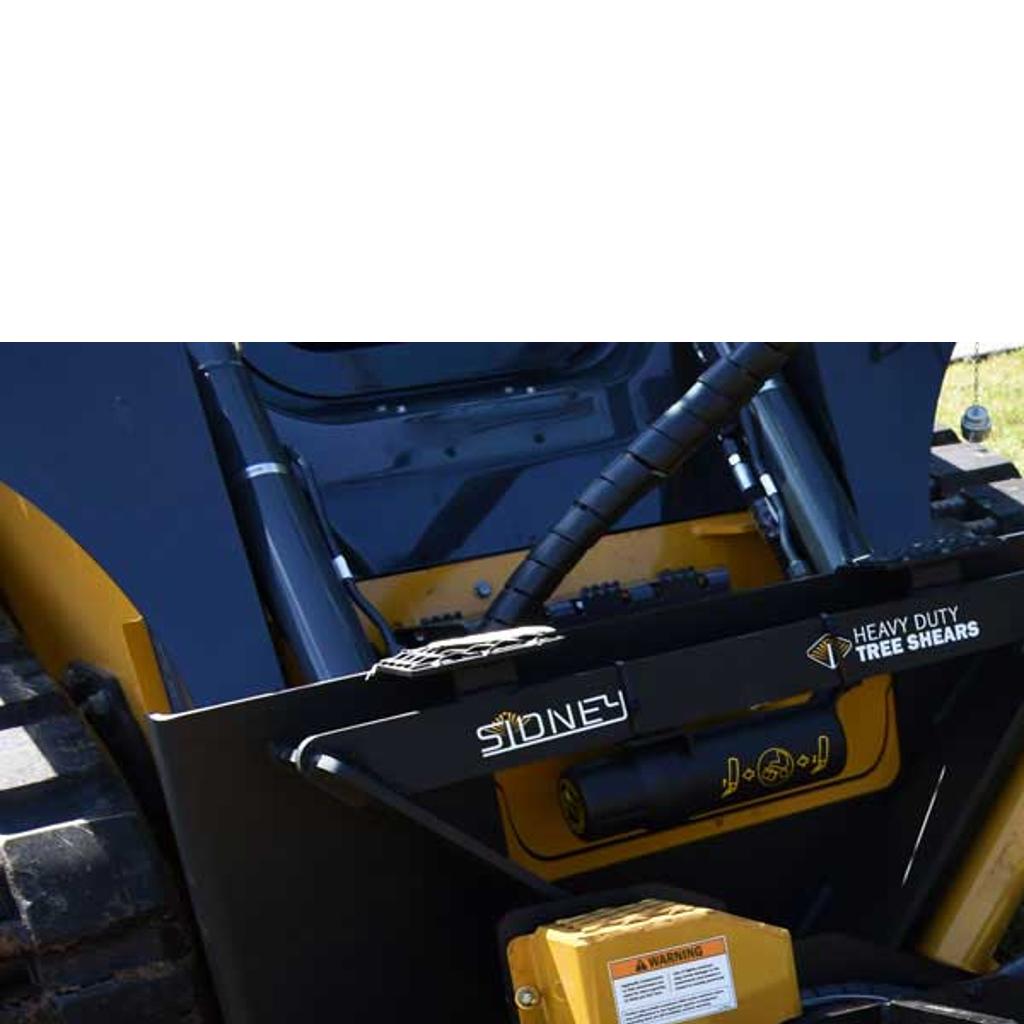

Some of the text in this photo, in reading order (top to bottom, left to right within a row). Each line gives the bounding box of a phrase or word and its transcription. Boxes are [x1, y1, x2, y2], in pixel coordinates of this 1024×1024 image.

[853, 605, 959, 644] HEAVY DUTY
[855, 620, 980, 662] TREE SHEARS
[476, 690, 628, 758] SIDNEY
[648, 945, 704, 967] WARNING
